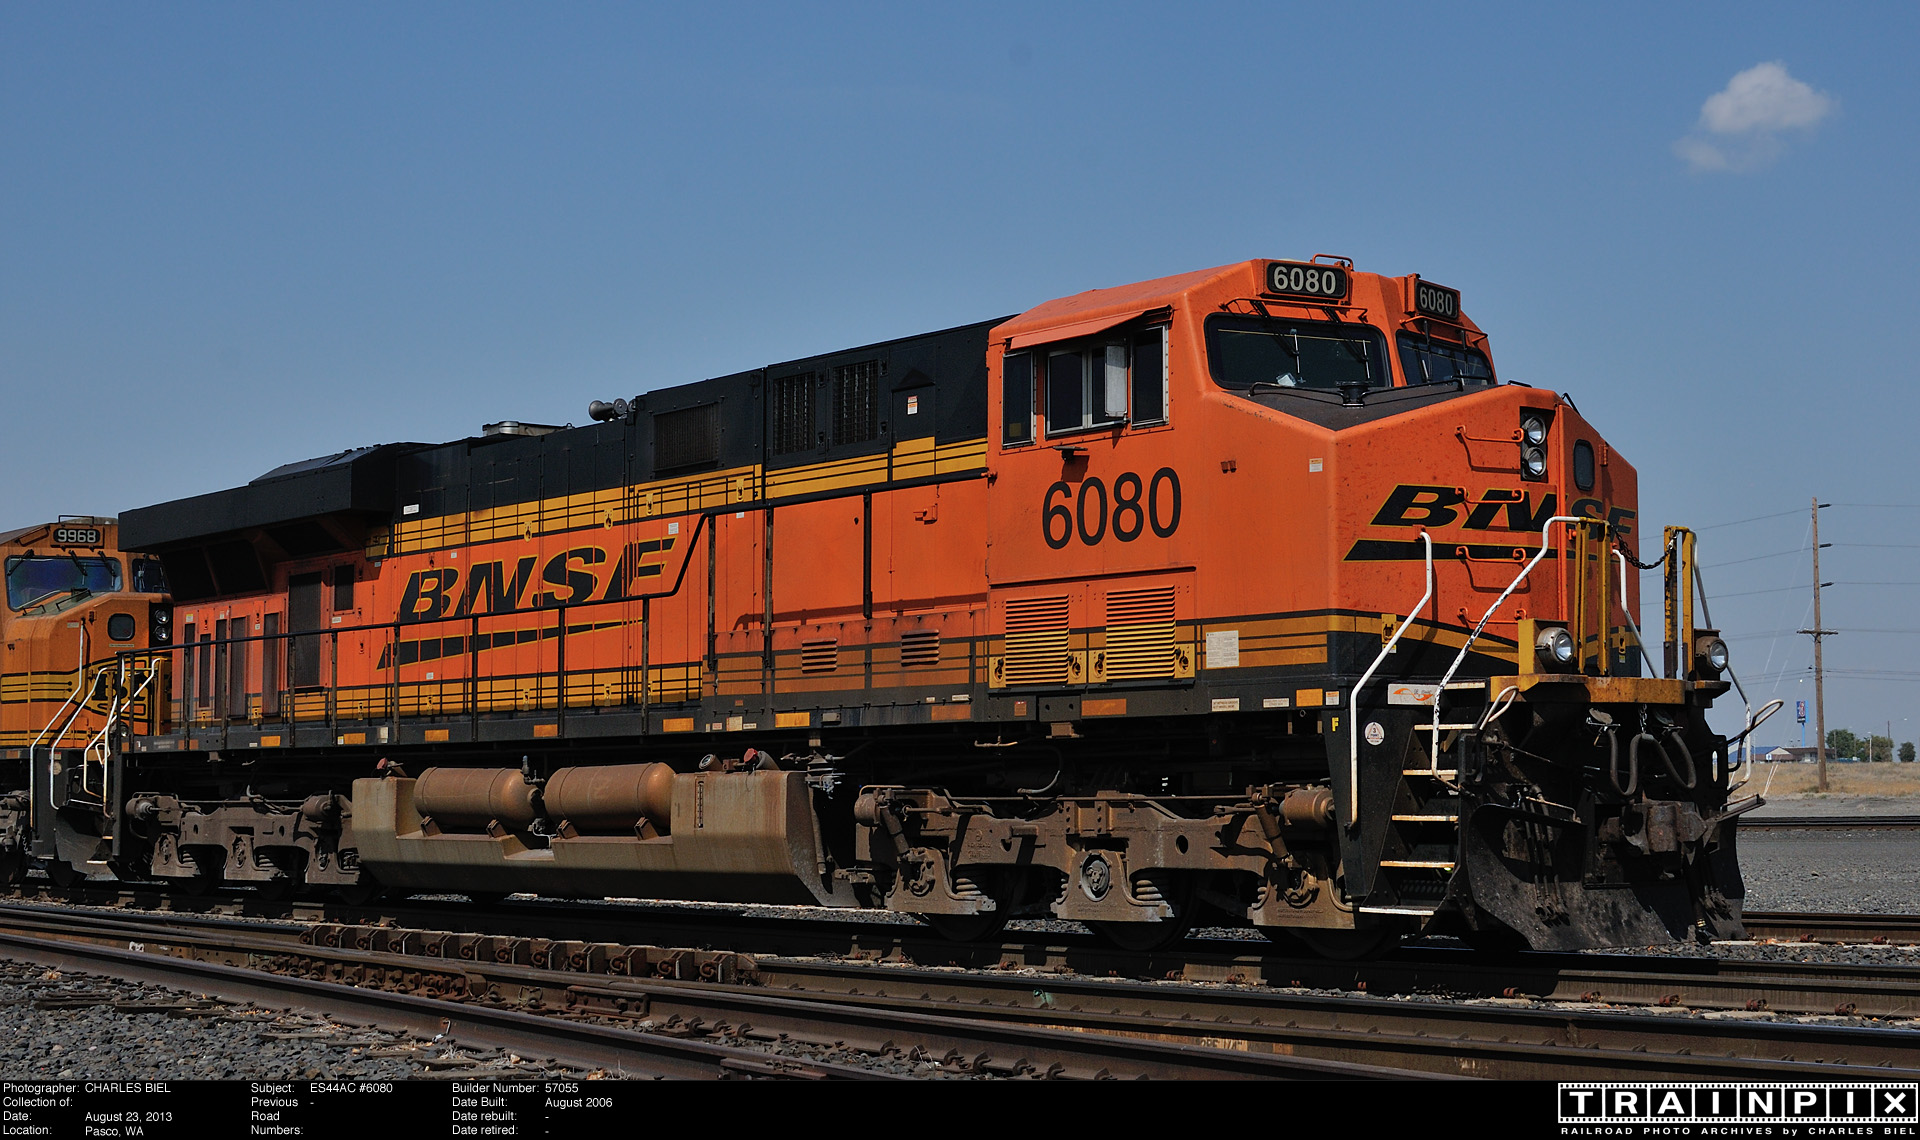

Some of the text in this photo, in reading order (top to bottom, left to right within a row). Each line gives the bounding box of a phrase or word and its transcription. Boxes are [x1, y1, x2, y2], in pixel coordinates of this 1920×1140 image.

[1274, 266, 1336, 295] 6080
[1420, 286, 1453, 316] 6080
[1042, 467, 1182, 550] 6080
[1369, 484, 1637, 542] BNSF
[57, 529, 96, 543] 9968
[394, 536, 678, 625] BNSF
[1331, 717, 1339, 732] F
